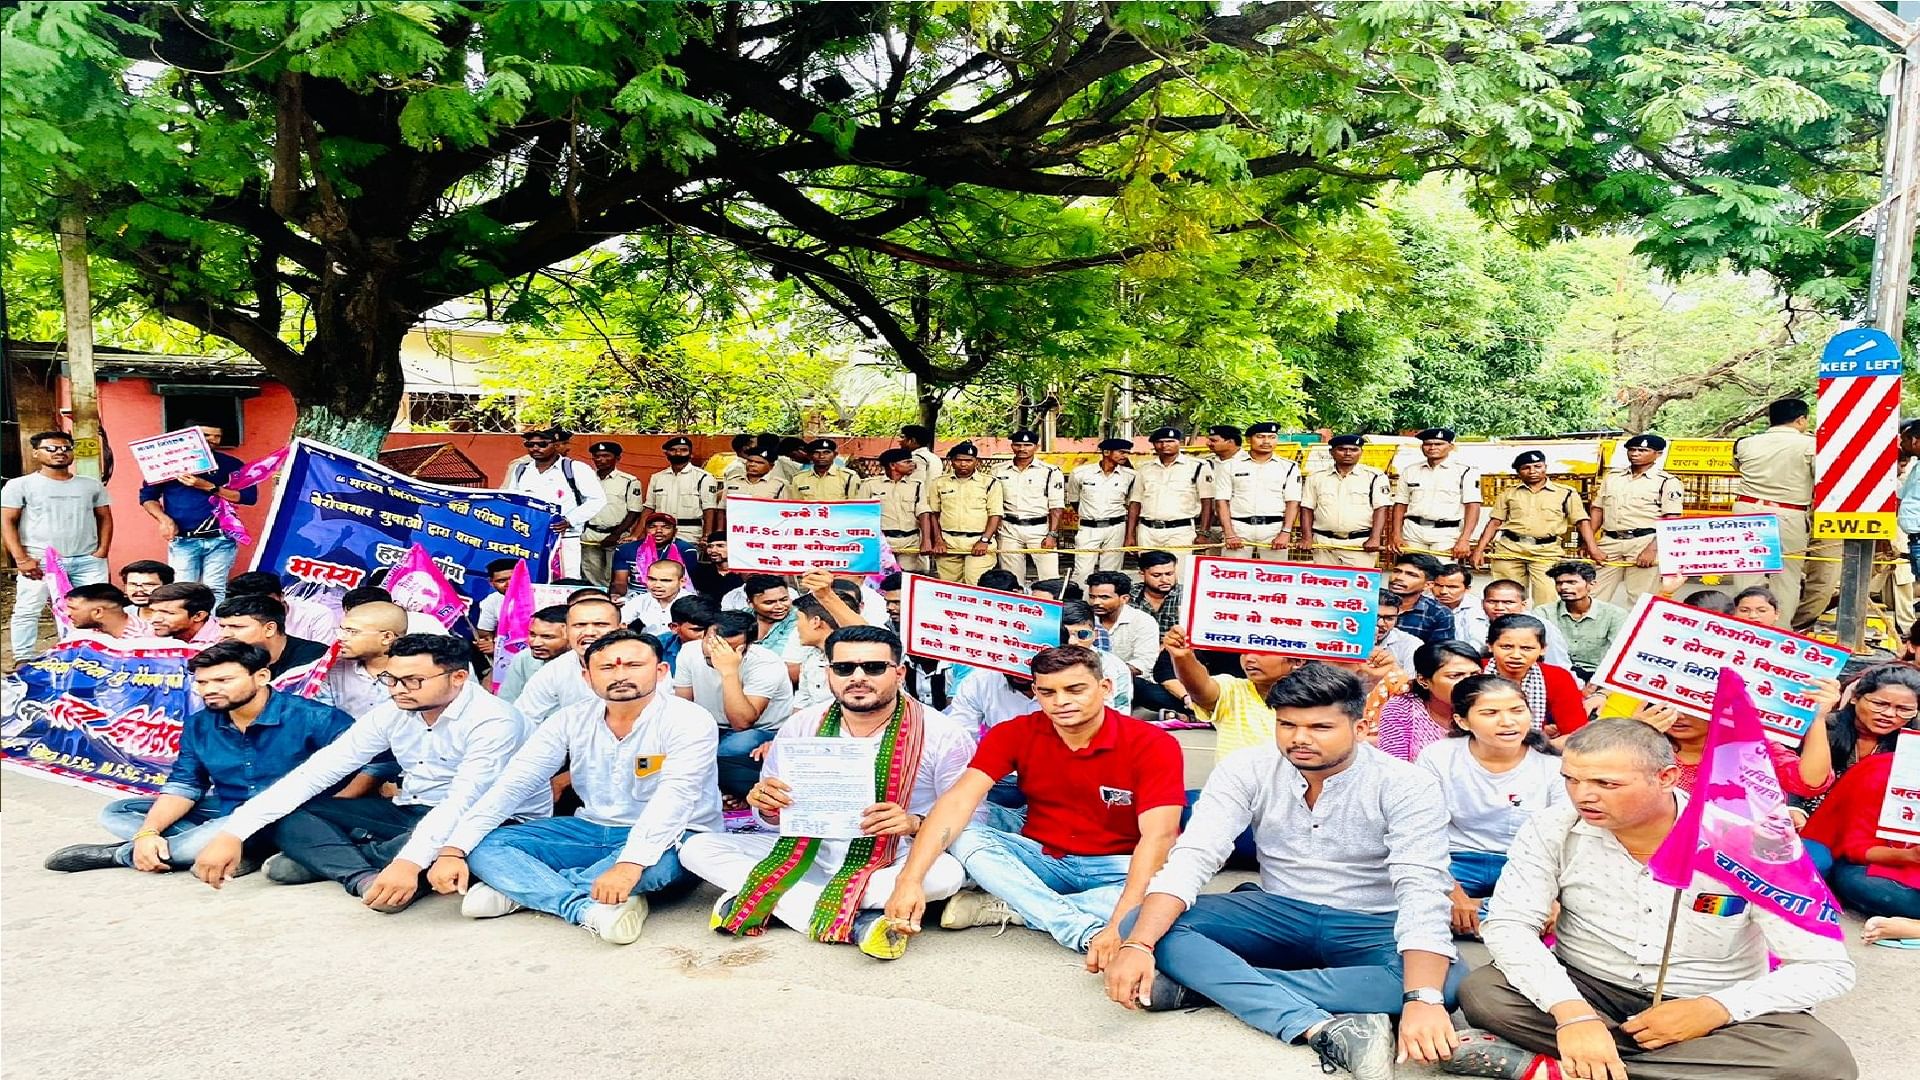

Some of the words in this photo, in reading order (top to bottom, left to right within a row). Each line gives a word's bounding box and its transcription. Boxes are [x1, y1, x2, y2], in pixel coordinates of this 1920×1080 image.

[1821, 361, 1857, 372] KEEP
[1865, 359, 1901, 371] LEFT
[1819, 519, 1889, 535] P.W.D.
[289, 557, 363, 589] मत्स्य
[1210, 565, 1247, 581] देखत
[1255, 568, 1293, 583] देखत
[1301, 573, 1348, 587] निकल
[1356, 576, 1371, 589] गे
[949, 624, 959, 635] के
[1214, 611, 1239, 622] अब
[1246, 611, 1262, 624] तो
[1270, 617, 1302, 627] कका
[1346, 619, 1358, 633] दे
[1204, 633, 1241, 643] मत्स्य
[1662, 612, 1699, 628] कका
[1705, 621, 1773, 649] फिशरीज
[1780, 640, 1799, 656] के
[1804, 648, 1836, 667] छेत्र
[1662, 635, 1677, 646] म
[1683, 638, 1726, 660] होवत
[1732, 649, 1748, 666] हे
[1624, 671, 1642, 682] ल
[1649, 674, 1668, 691] तो
[1636, 651, 1678, 669] मत्स्य
[1756, 680, 1774, 697] के
[1716, 852, 1814, 916] चलाता
